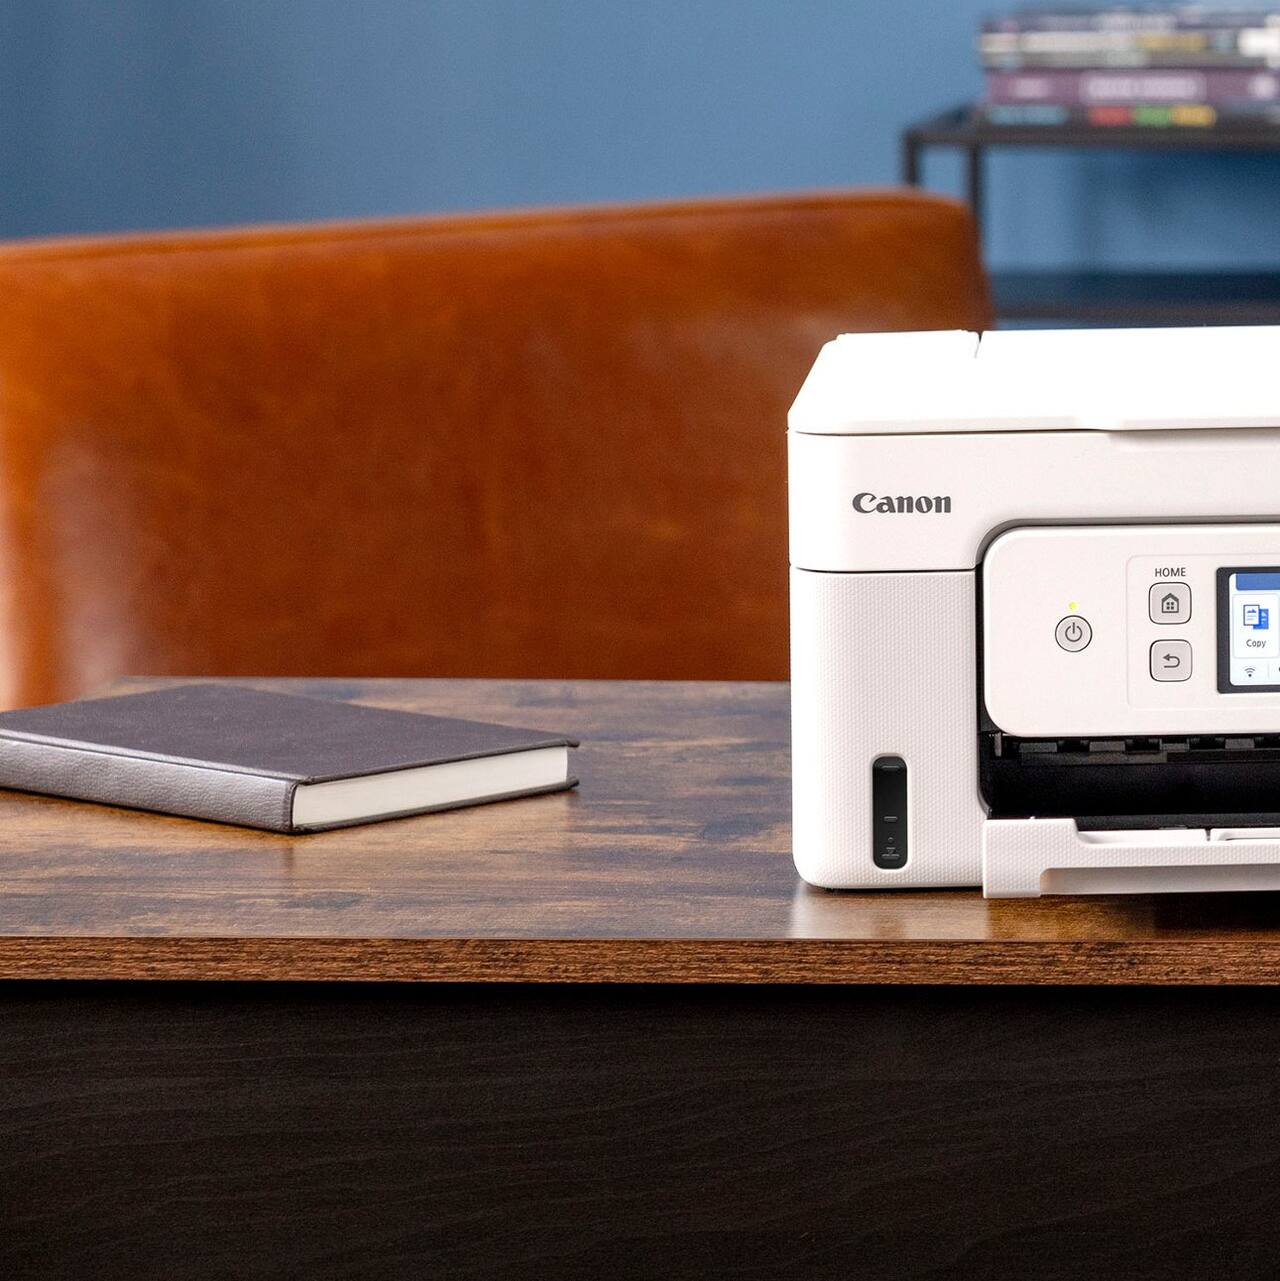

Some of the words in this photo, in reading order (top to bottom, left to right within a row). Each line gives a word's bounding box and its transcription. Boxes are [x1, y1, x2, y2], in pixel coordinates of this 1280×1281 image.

[852, 492, 951, 514] Canon
[1154, 567, 1187, 578] HOME
[1246, 638, 1267, 648] Copy
